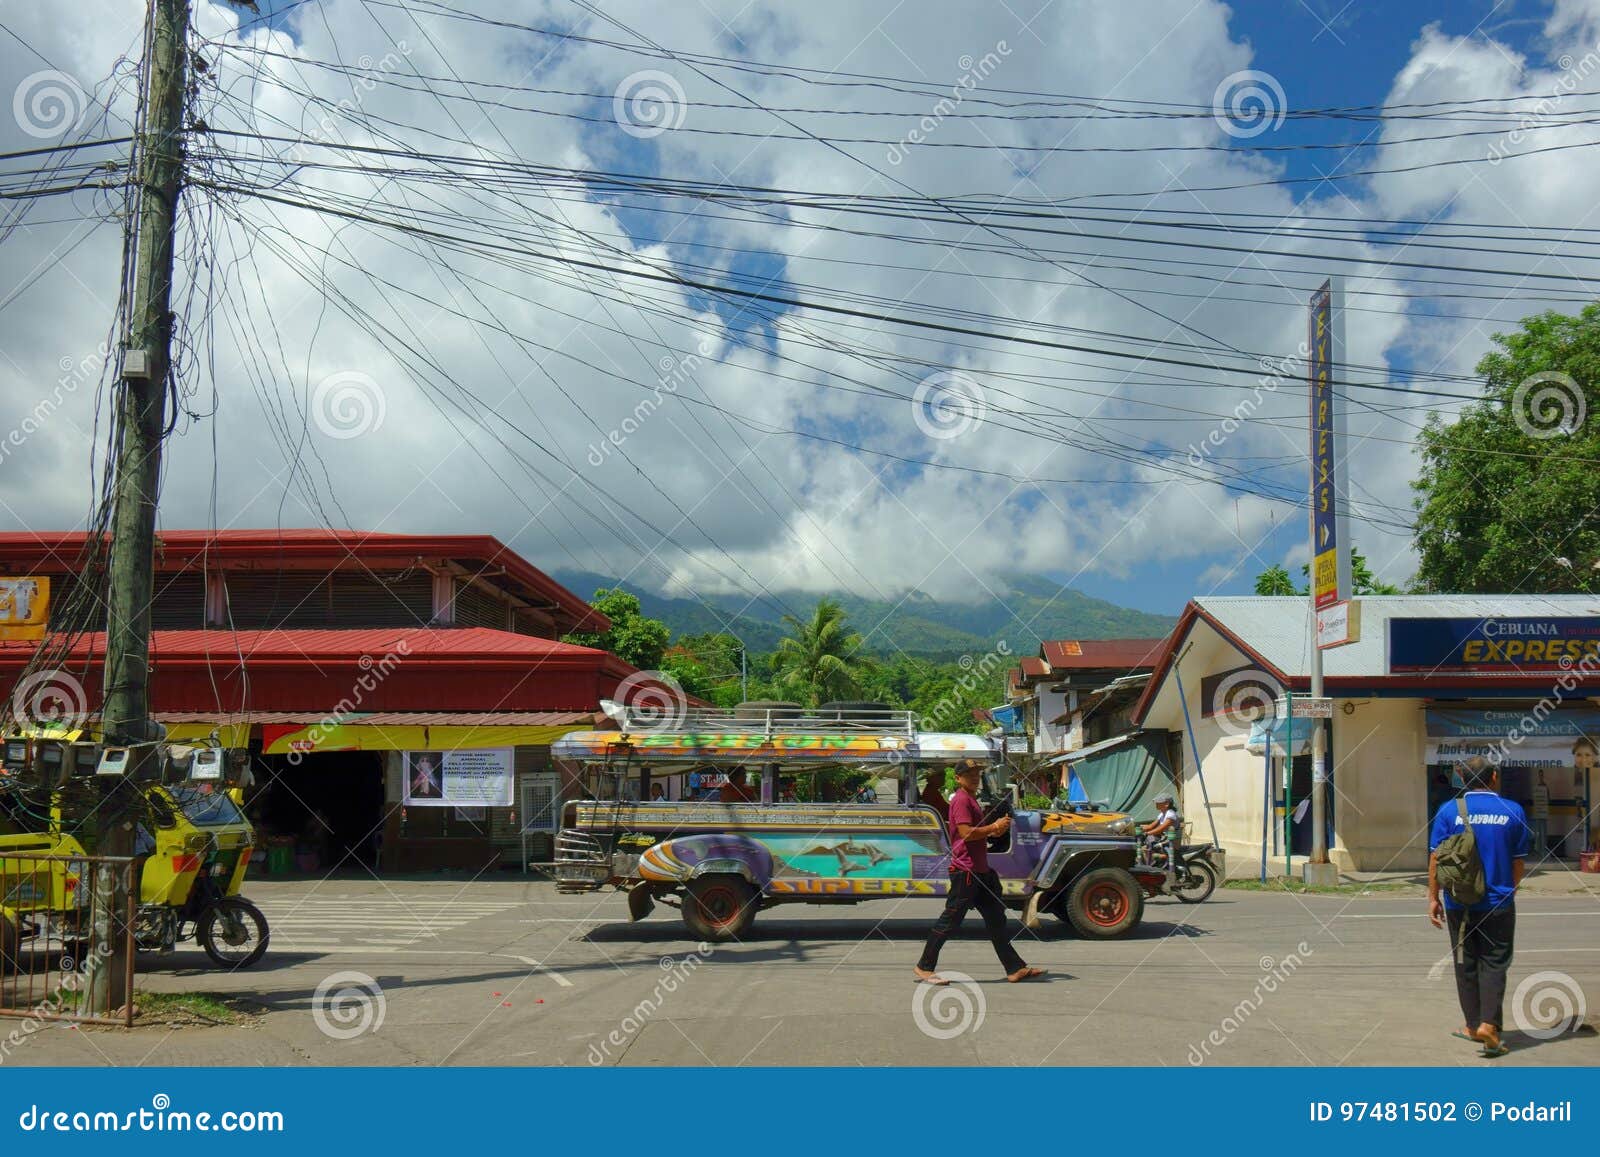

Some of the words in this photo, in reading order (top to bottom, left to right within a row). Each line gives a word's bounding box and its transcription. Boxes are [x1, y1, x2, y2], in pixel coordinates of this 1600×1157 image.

[1317, 310, 1329, 512] EXPRESS
[1483, 620, 1558, 637] CEBUANA
[1463, 640, 1600, 662] EXPRESS
[1455, 814, 1510, 825] MLAYBALAY
[769, 879, 1025, 894] SUPERSR
